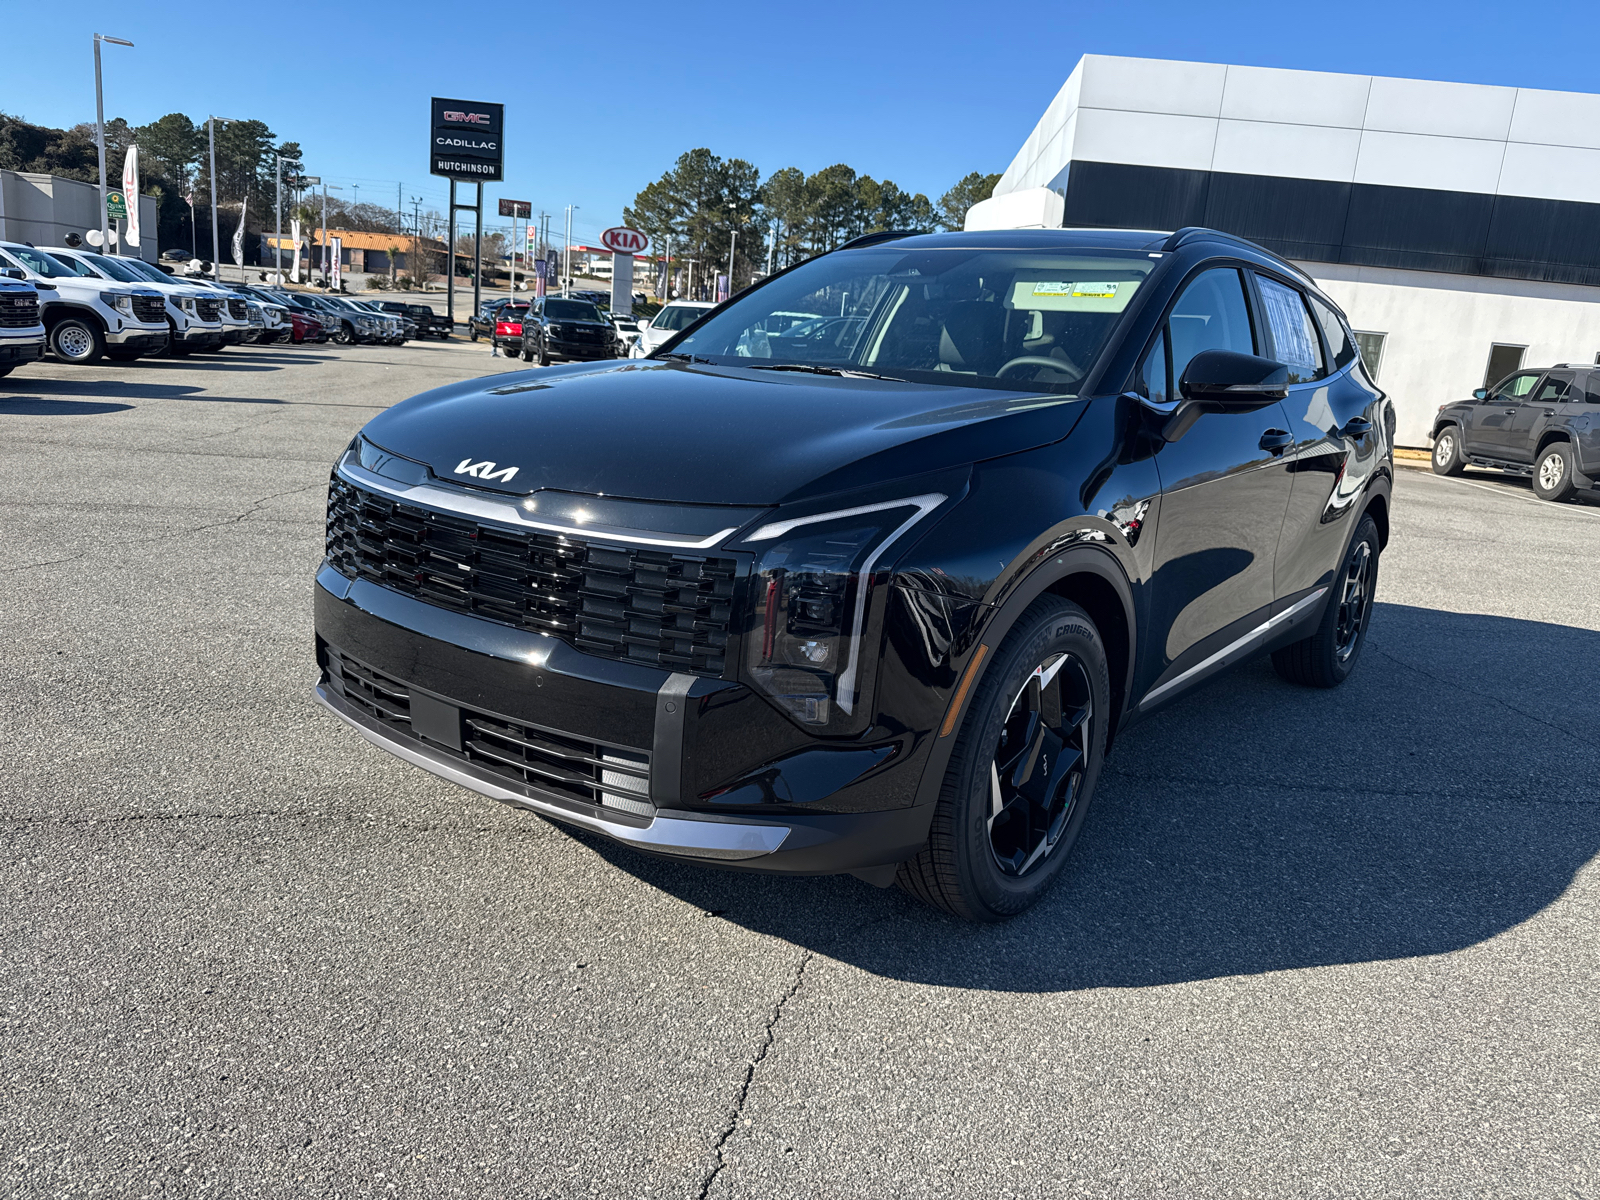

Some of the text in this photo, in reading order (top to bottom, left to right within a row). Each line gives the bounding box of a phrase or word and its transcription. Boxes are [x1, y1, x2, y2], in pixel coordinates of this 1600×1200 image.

[443, 110, 490, 125] GMC
[436, 137, 496, 150] CADILLAC
[438, 160, 495, 174] HUTCHINSON
[610, 231, 641, 249] KIA
[454, 458, 519, 483] KIA
[1055, 624, 1094, 641] CRUGEN
